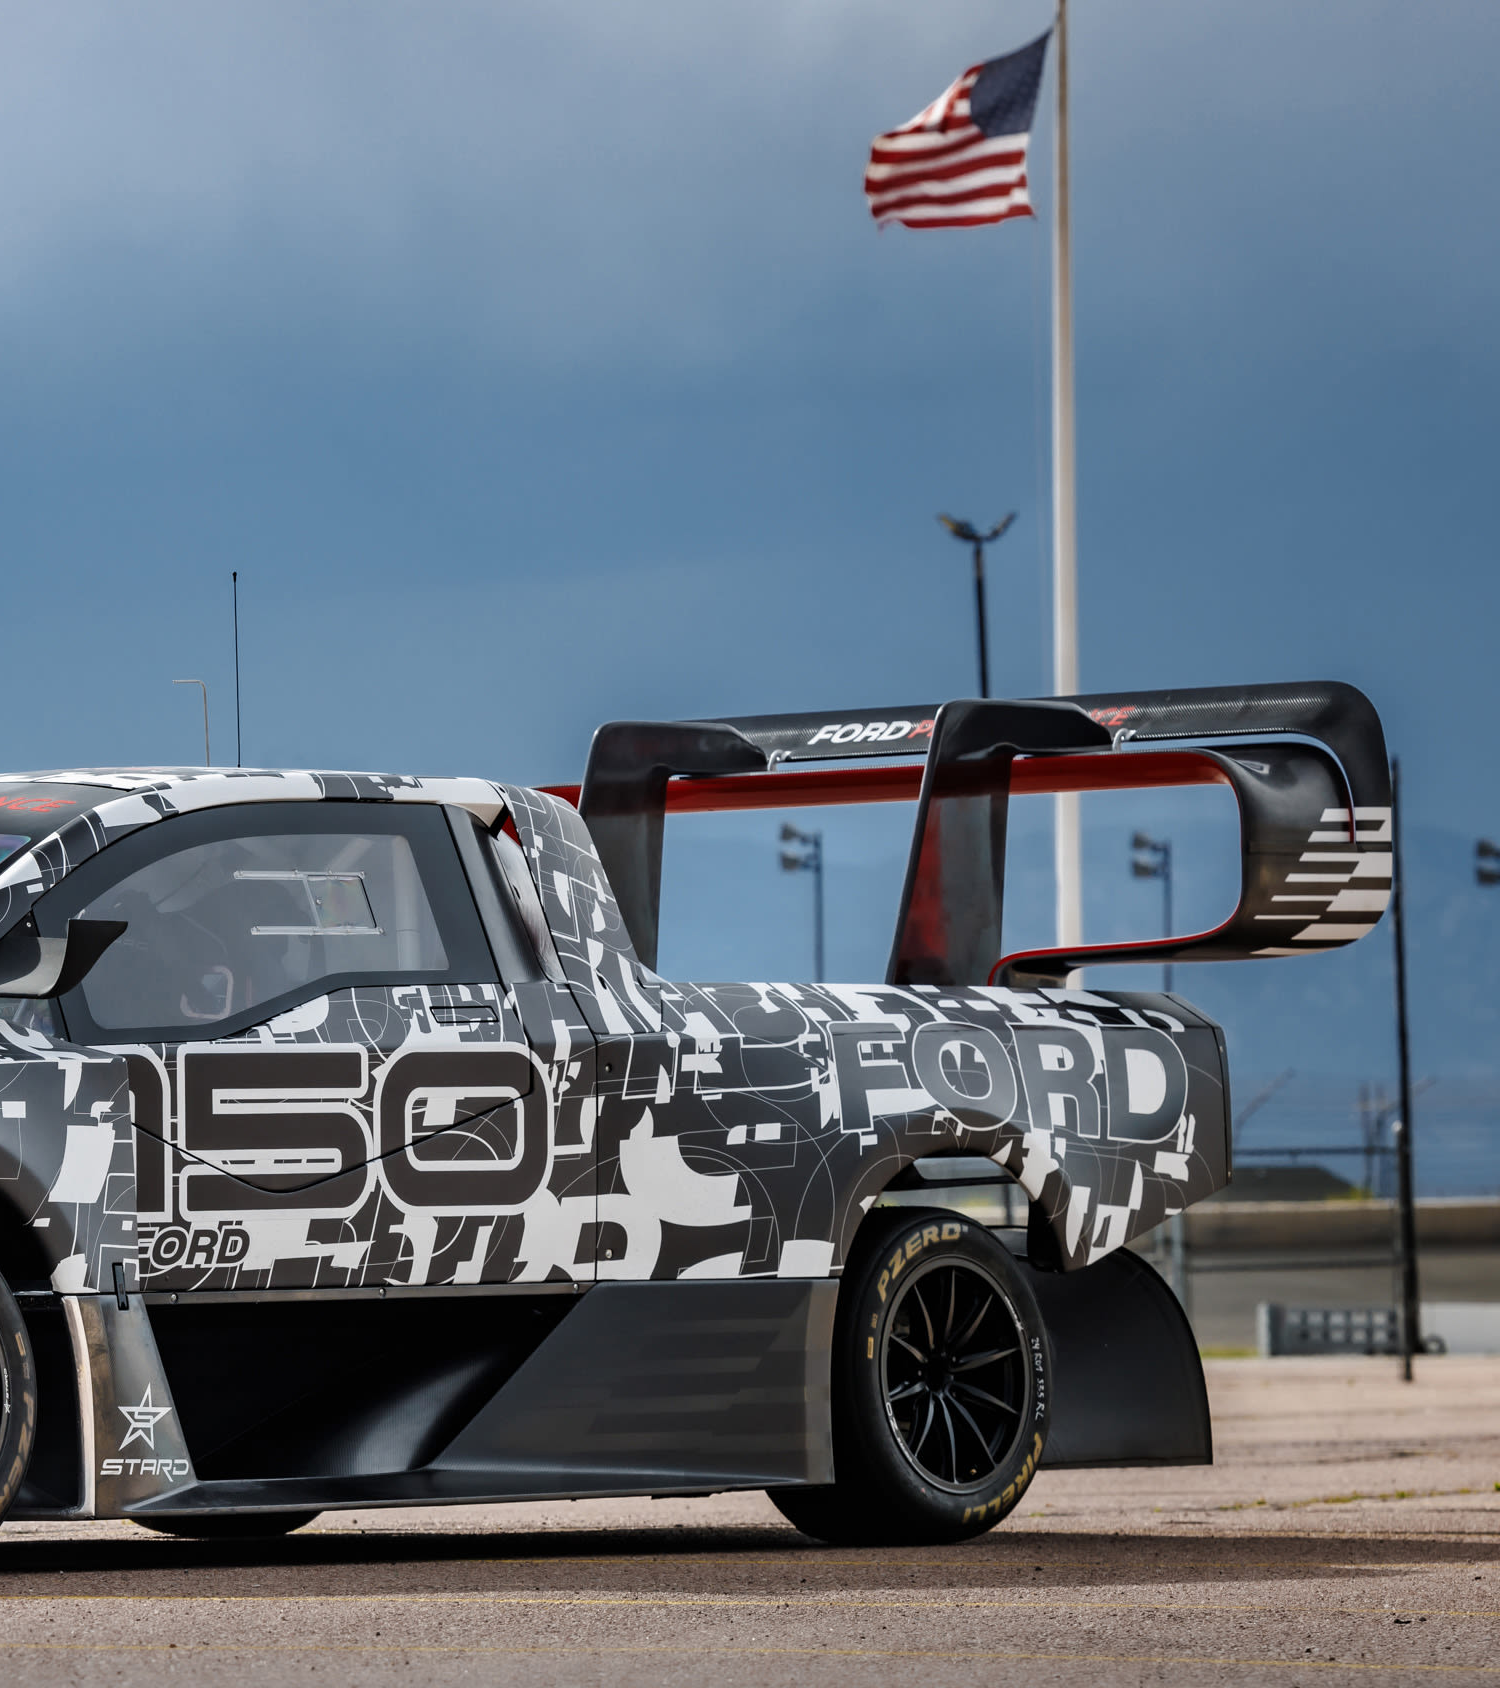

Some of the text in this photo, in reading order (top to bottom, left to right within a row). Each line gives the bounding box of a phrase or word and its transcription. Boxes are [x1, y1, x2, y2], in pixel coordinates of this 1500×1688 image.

[807, 720, 912, 745] FORD
[826, 1020, 1188, 1144] FORD
[100, 1458, 189, 1483] STARD
[962, 1432, 1043, 1525] PIRELLI
